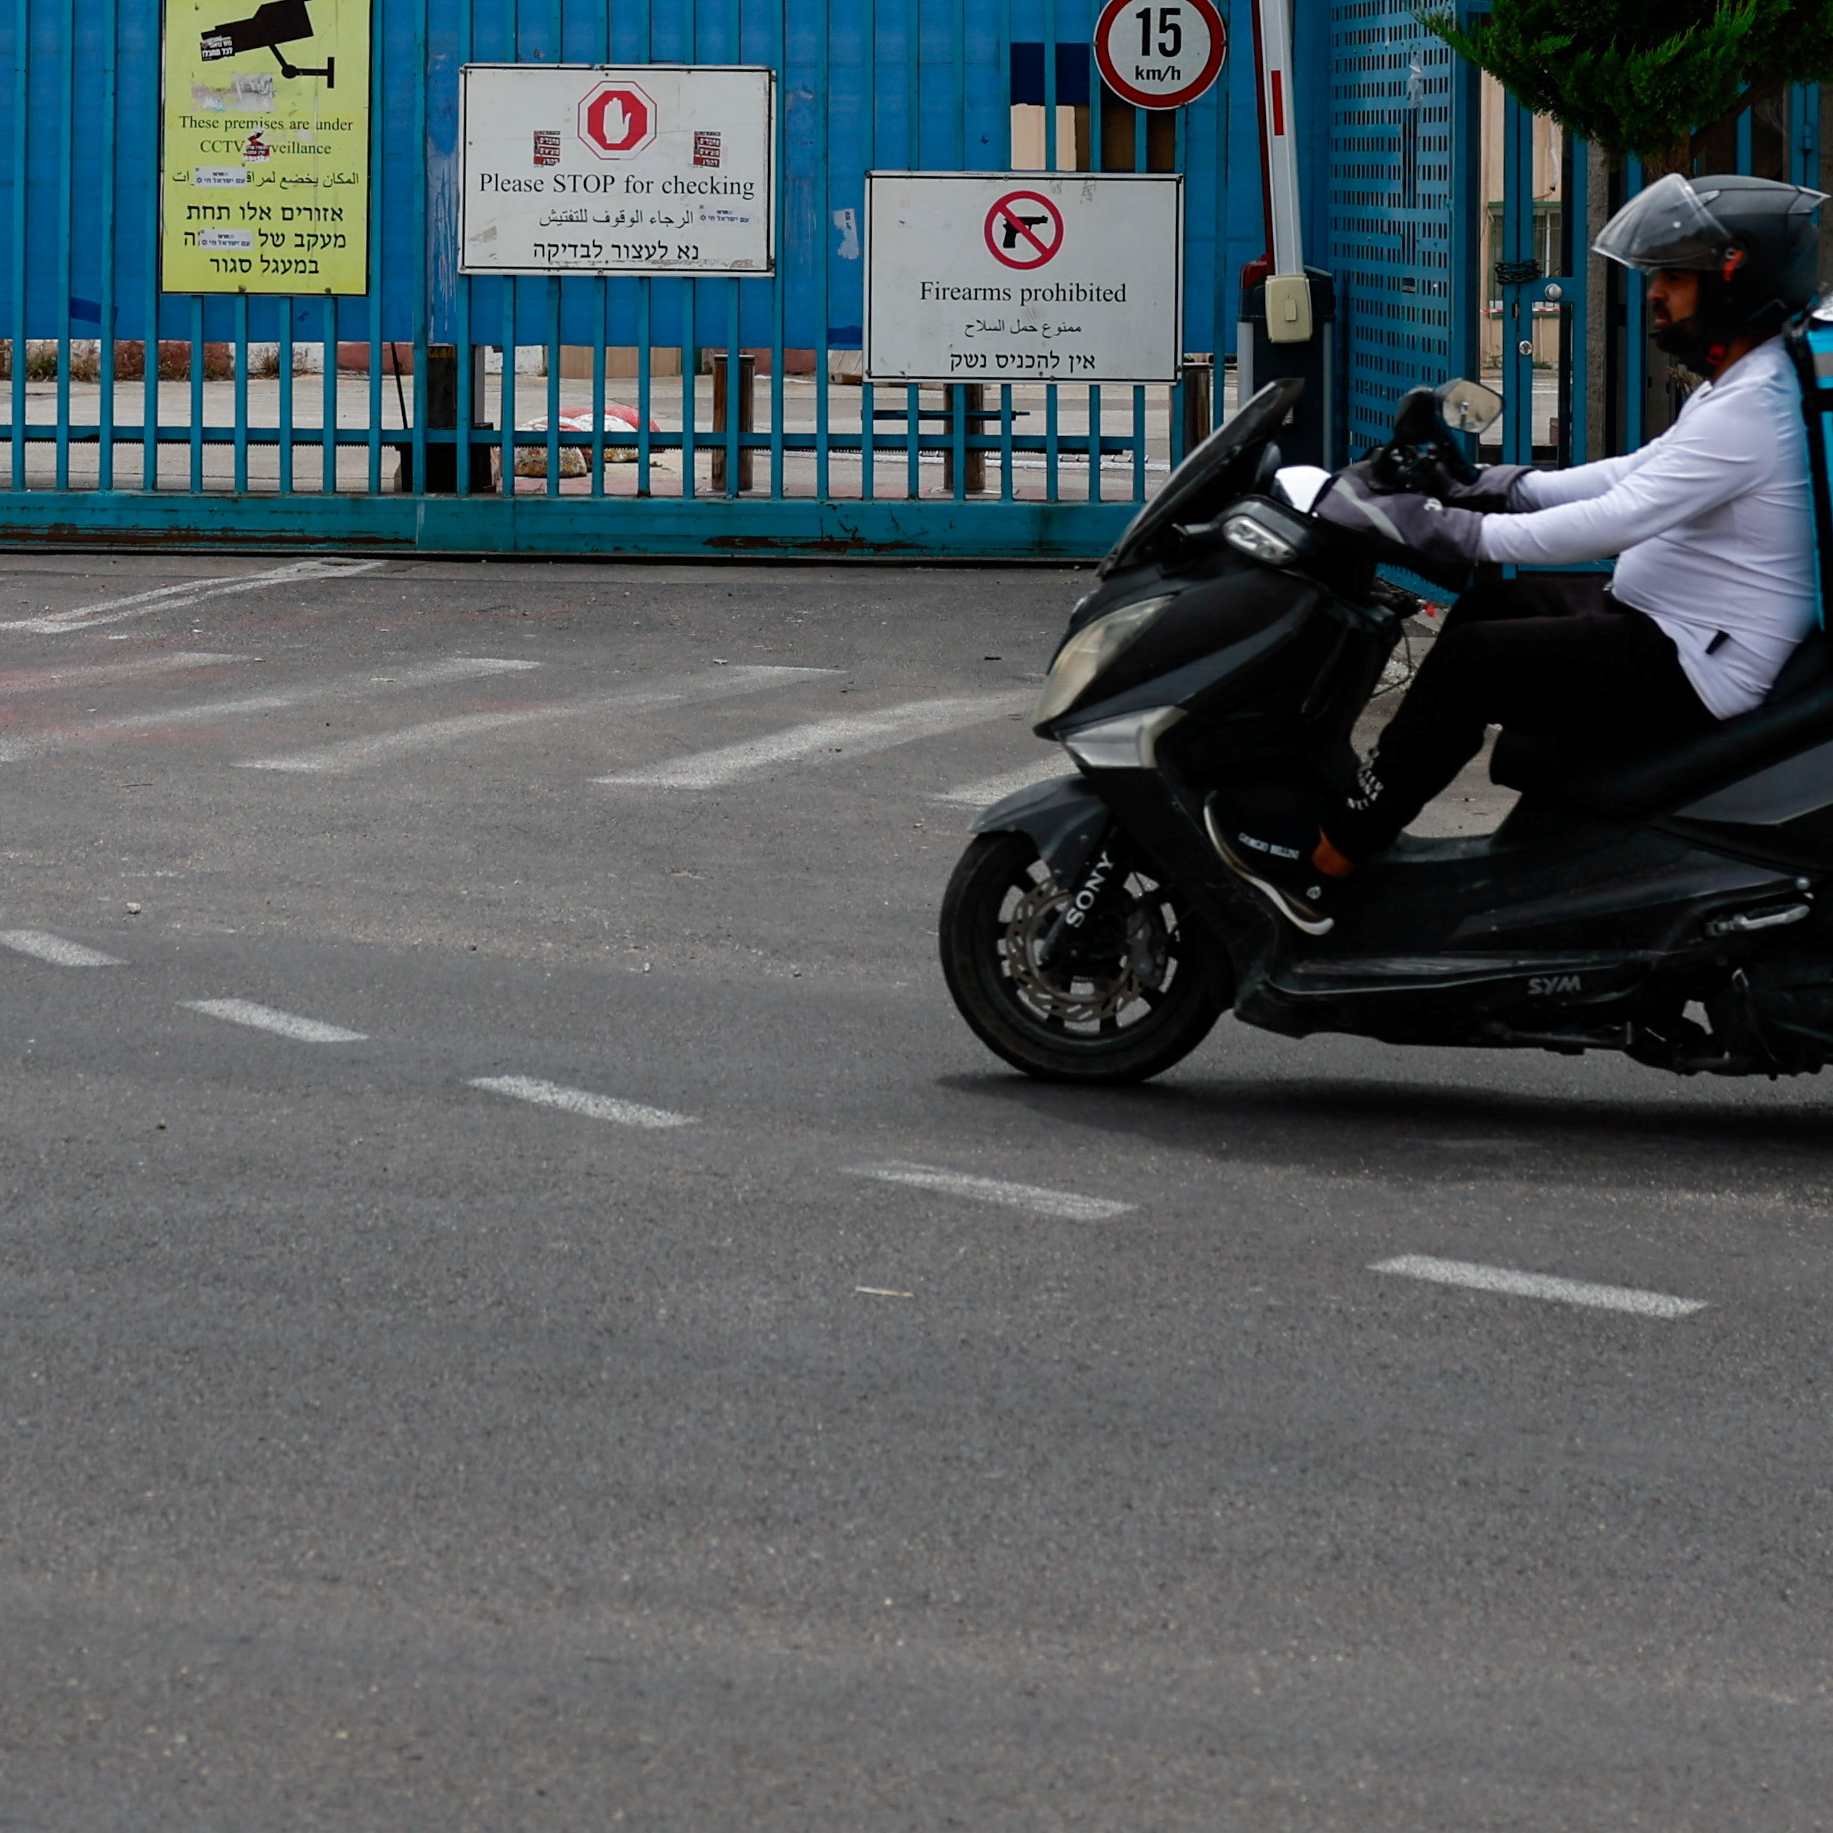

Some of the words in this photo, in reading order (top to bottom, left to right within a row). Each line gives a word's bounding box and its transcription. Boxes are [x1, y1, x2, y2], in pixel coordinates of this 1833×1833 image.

[1135, 7, 1182, 58] 15
[1135, 66, 1182, 82] km/h
[179, 116, 219, 129] These
[224, 117, 285, 132] premises
[289, 120, 309, 130] are
[316, 118, 354, 131] under
[200, 140, 245, 153] CCTV
[279, 172, 318, 190] يخضع
[323, 171, 359, 188] المكان
[479, 173, 544, 193] Please
[553, 174, 615, 193] STOP
[624, 175, 654, 194] for
[661, 175, 755, 200] checking
[186, 205, 230, 220] תחת
[239, 201, 271, 221] אלו
[281, 205, 344, 222] אזורים
[539, 208, 588, 226] للتفتيش
[593, 210, 643, 226] الوقوف
[650, 210, 693, 228] الرجاء
[258, 228, 285, 248] של
[294, 233, 347, 252] מעקב
[533, 240, 603, 261] לבדיקה
[611, 240, 668, 260] לעצור
[676, 245, 699, 260] נא
[209, 258, 252, 273] סגור
[260, 254, 320, 275] במעגל
[920, 281, 1011, 301] Firearms
[1019, 282, 1127, 306] prohibited
[964, 318, 1005, 337] السلاح
[1010, 319, 1037, 335] حمل
[1041, 320, 1081, 338] ممنوع
[950, 352, 987, 372] נשק
[995, 349, 1061, 368] להכניס
[1068, 352, 1096, 373] אין
[1065, 850, 1115, 929] SONY
[1528, 974, 1582, 995] SYM
